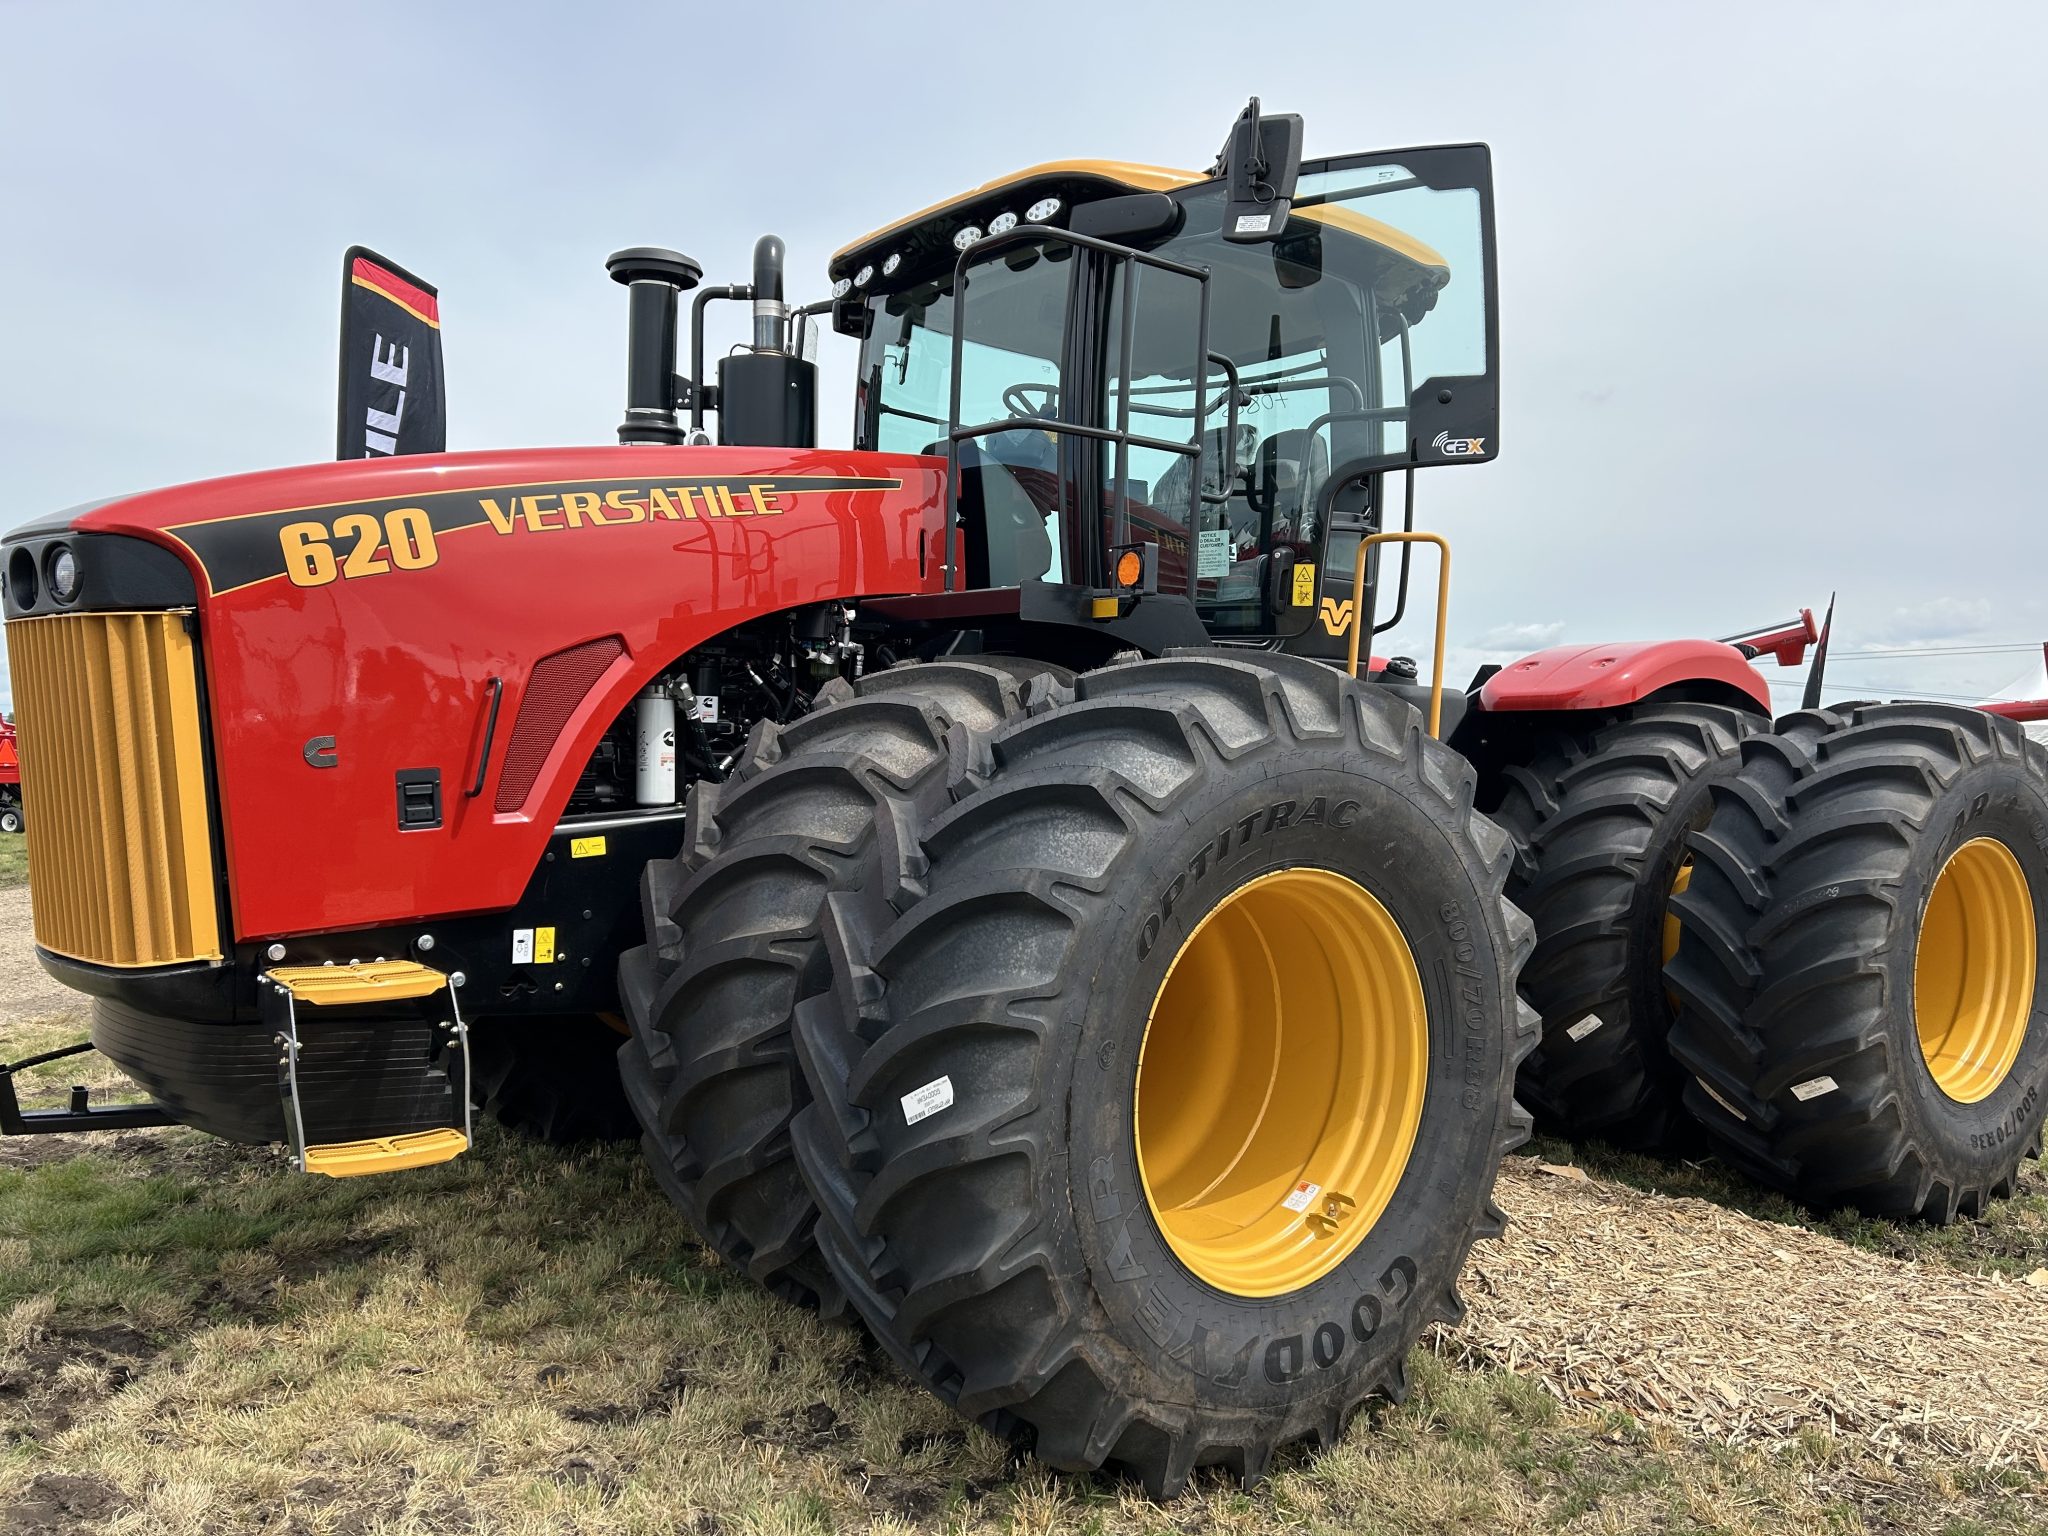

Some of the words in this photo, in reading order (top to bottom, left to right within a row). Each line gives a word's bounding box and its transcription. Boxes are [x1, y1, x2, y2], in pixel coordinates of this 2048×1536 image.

[365, 333, 409, 459] ILE
[1441, 437, 1486, 456] CBX
[279, 507, 439, 588] 620
[478, 484, 784, 536] VERSATILE
[1136, 794, 1363, 963] OPTITRAC
[1086, 1152, 1419, 1391] GOODYEAR
